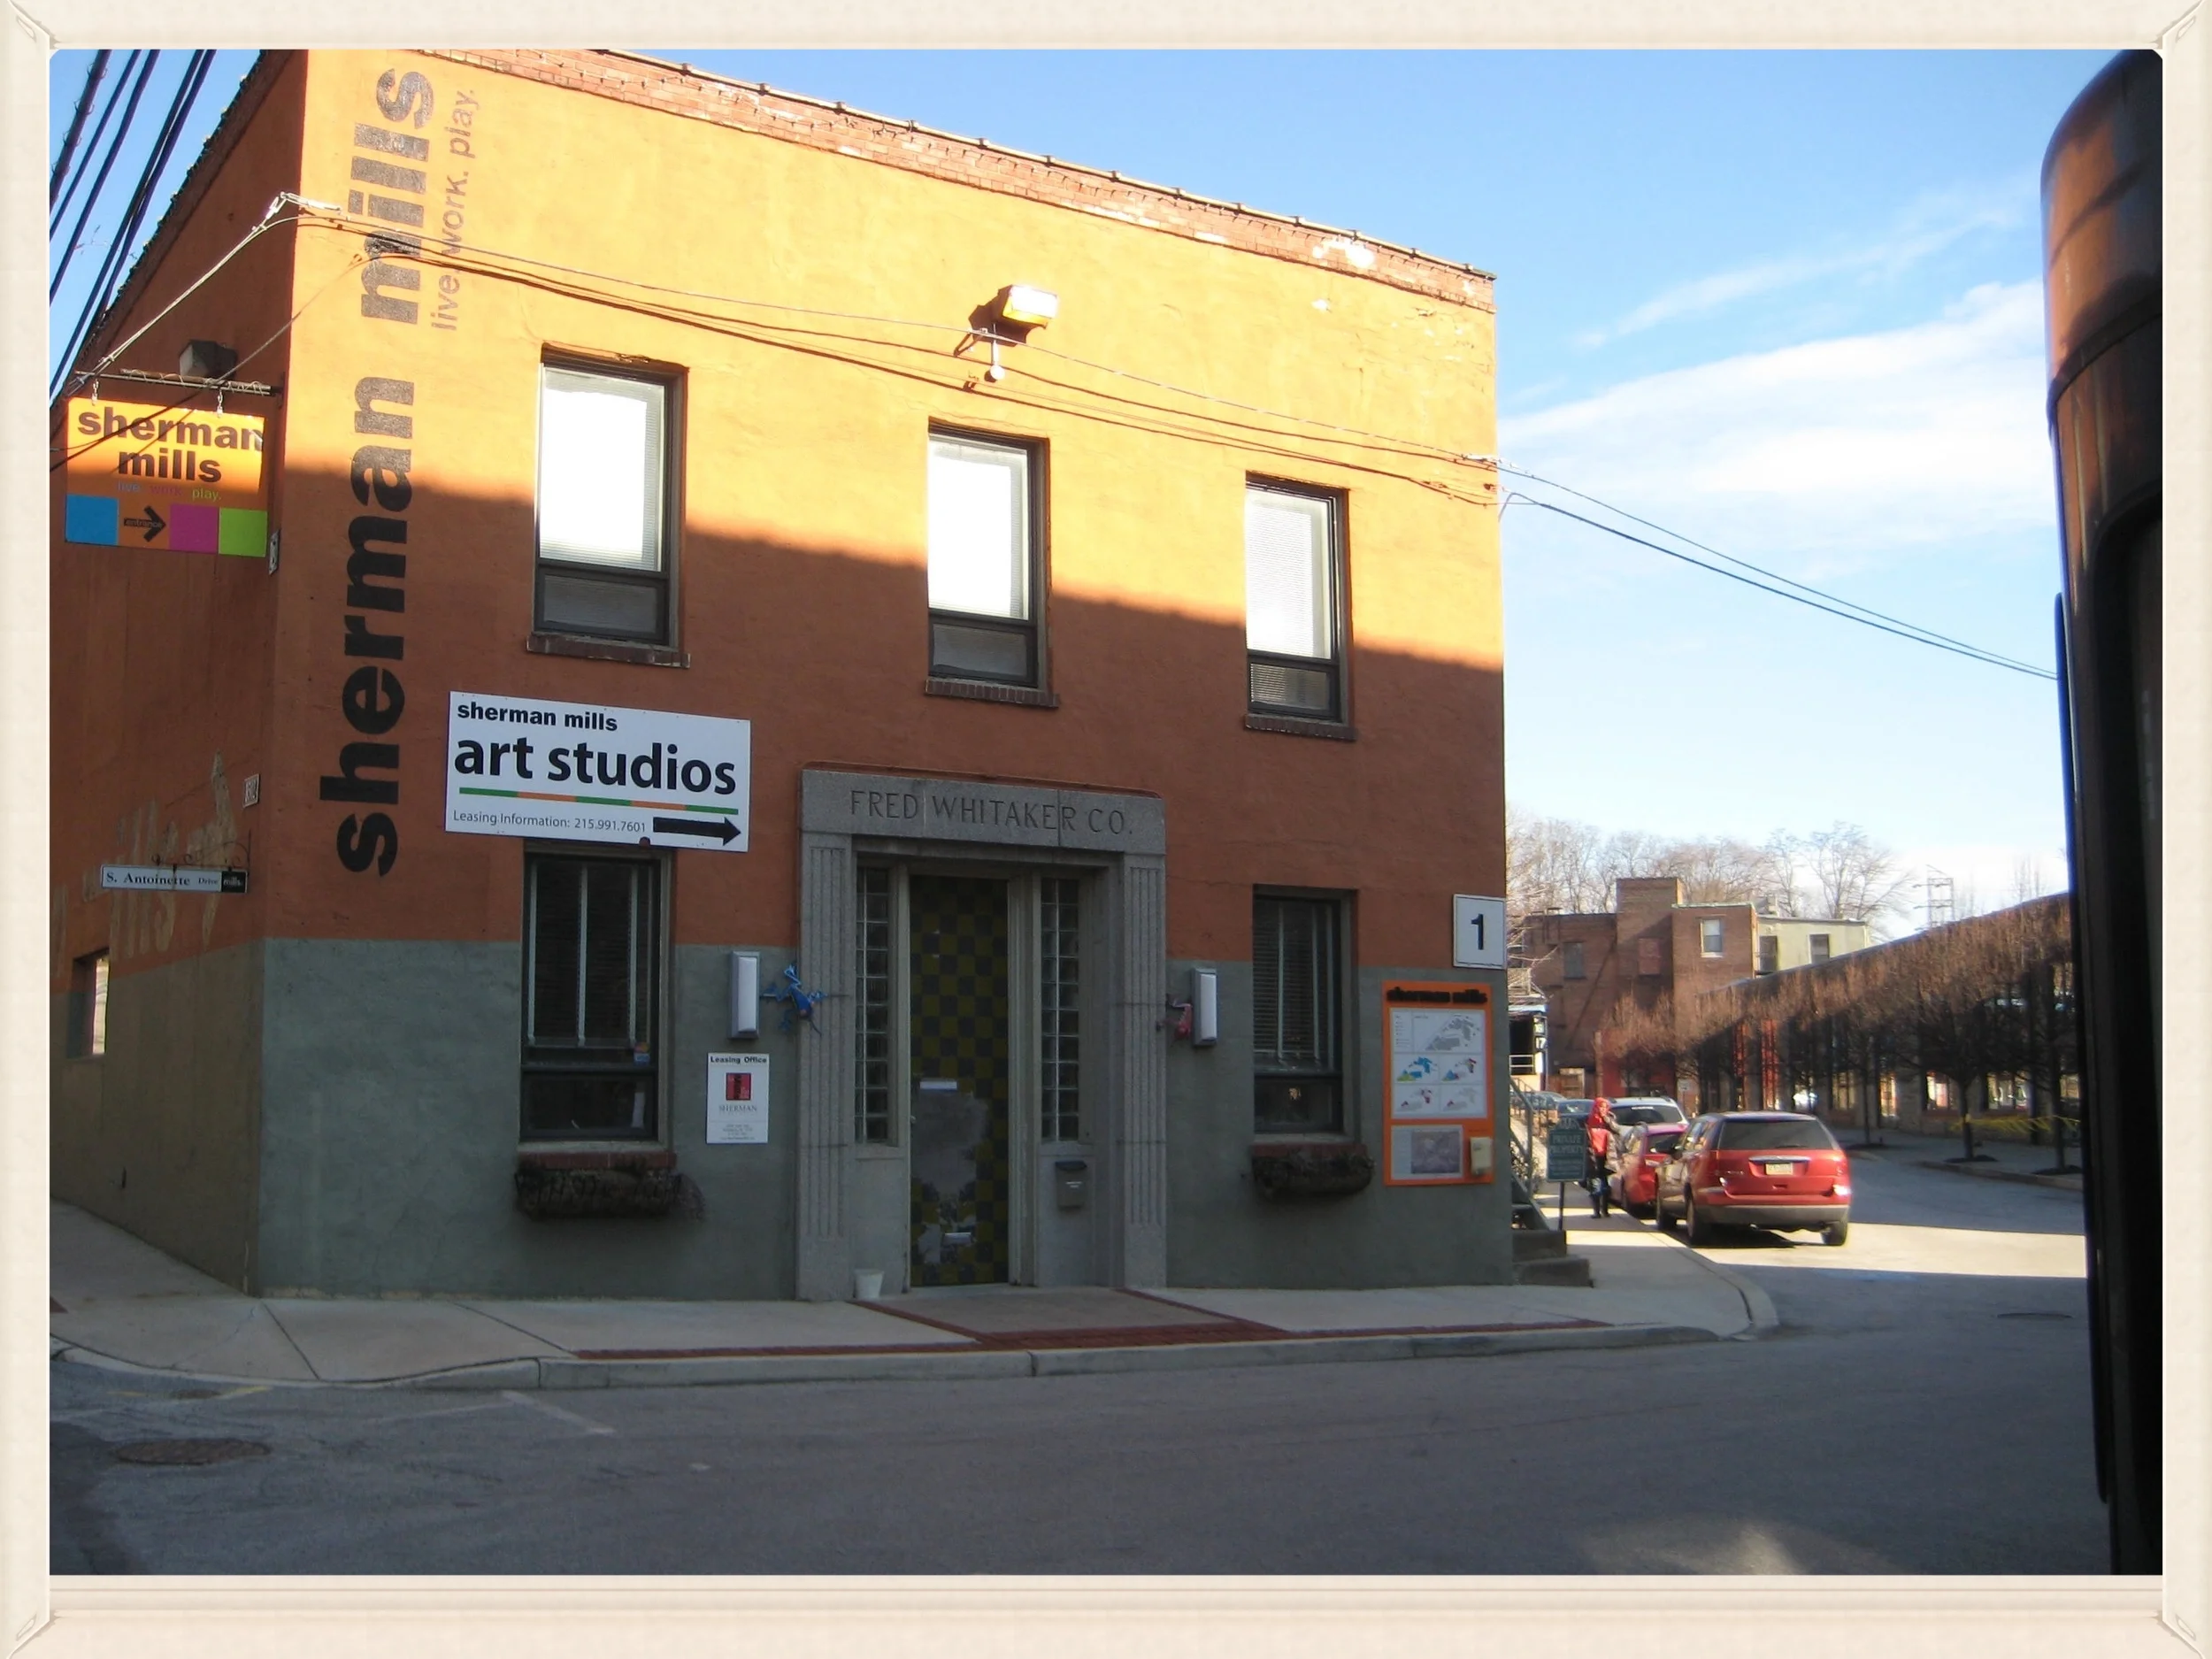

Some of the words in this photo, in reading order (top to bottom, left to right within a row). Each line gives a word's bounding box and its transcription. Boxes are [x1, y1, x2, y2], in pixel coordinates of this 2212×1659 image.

[444, 89, 480, 159] play.
[347, 68, 434, 325] mills
[78, 407, 264, 452] sherman
[119, 448, 222, 483] mills
[319, 376, 415, 877] sherman
[457, 702, 557, 726] sherman
[565, 710, 618, 732] mills
[454, 737, 534, 780] art
[547, 742, 738, 795] studios
[453, 810, 498, 826] Leasing
[500, 813, 571, 829] Information:
[574, 818, 646, 833] 215.991.7601
[849, 789, 919, 820] FRED
[932, 795, 1077, 832] WHITAKER
[1087, 808, 1133, 835] CO.
[106, 872, 118, 883] S.
[1471, 913, 1485, 951] 1
[710, 1056, 741, 1064] Leasing
